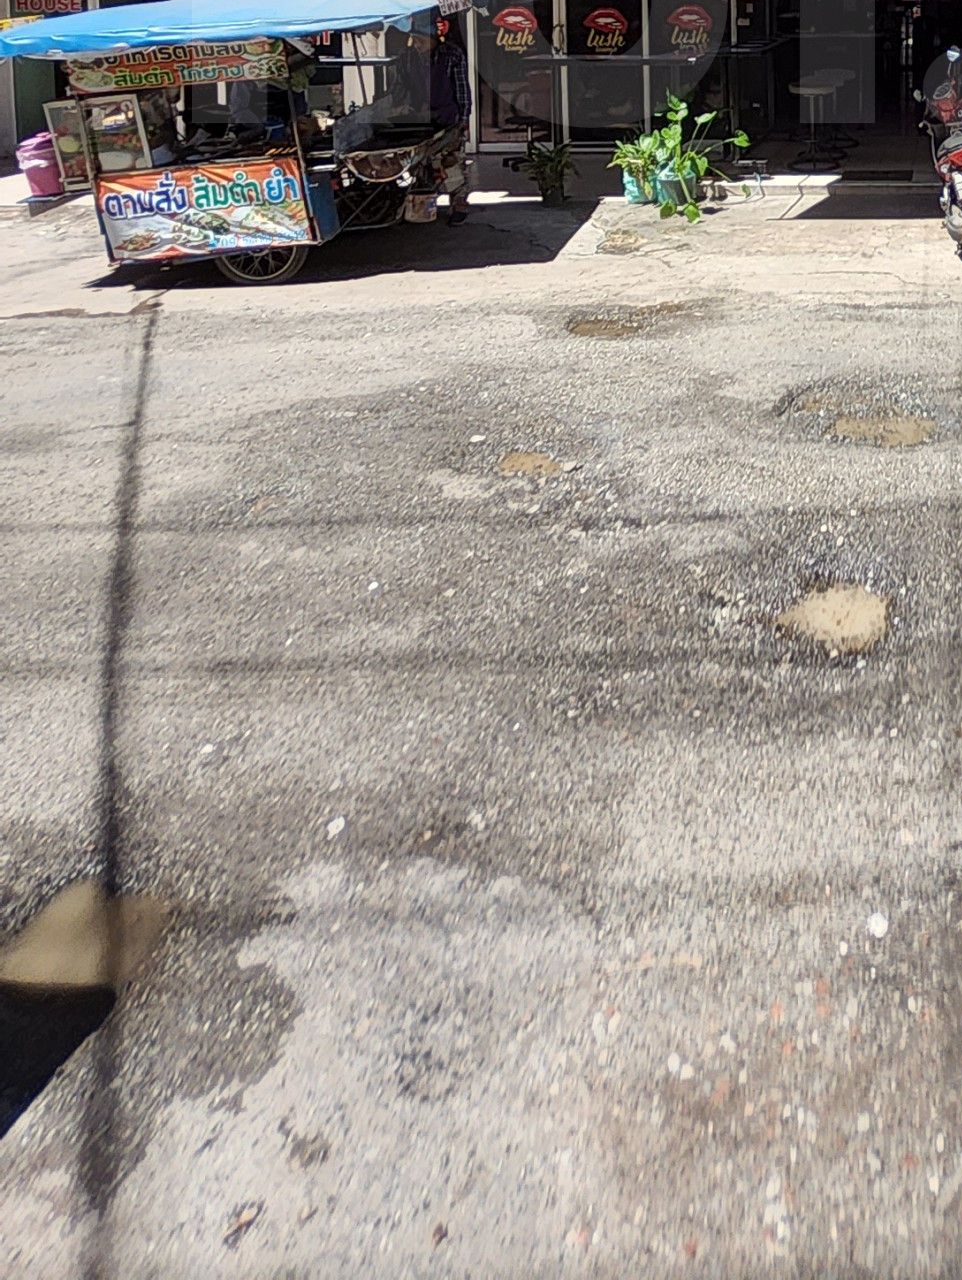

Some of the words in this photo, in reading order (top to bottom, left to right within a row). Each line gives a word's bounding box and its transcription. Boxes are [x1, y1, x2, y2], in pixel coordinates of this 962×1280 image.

[495, 27, 536, 46] lush
[586, 28, 627, 48] lush
[671, 25, 710, 46] lush
[104, 172, 189, 218] ตามสั่ง
[192, 171, 261, 210] ส้มตำ
[264, 167, 300, 203] ยำ
